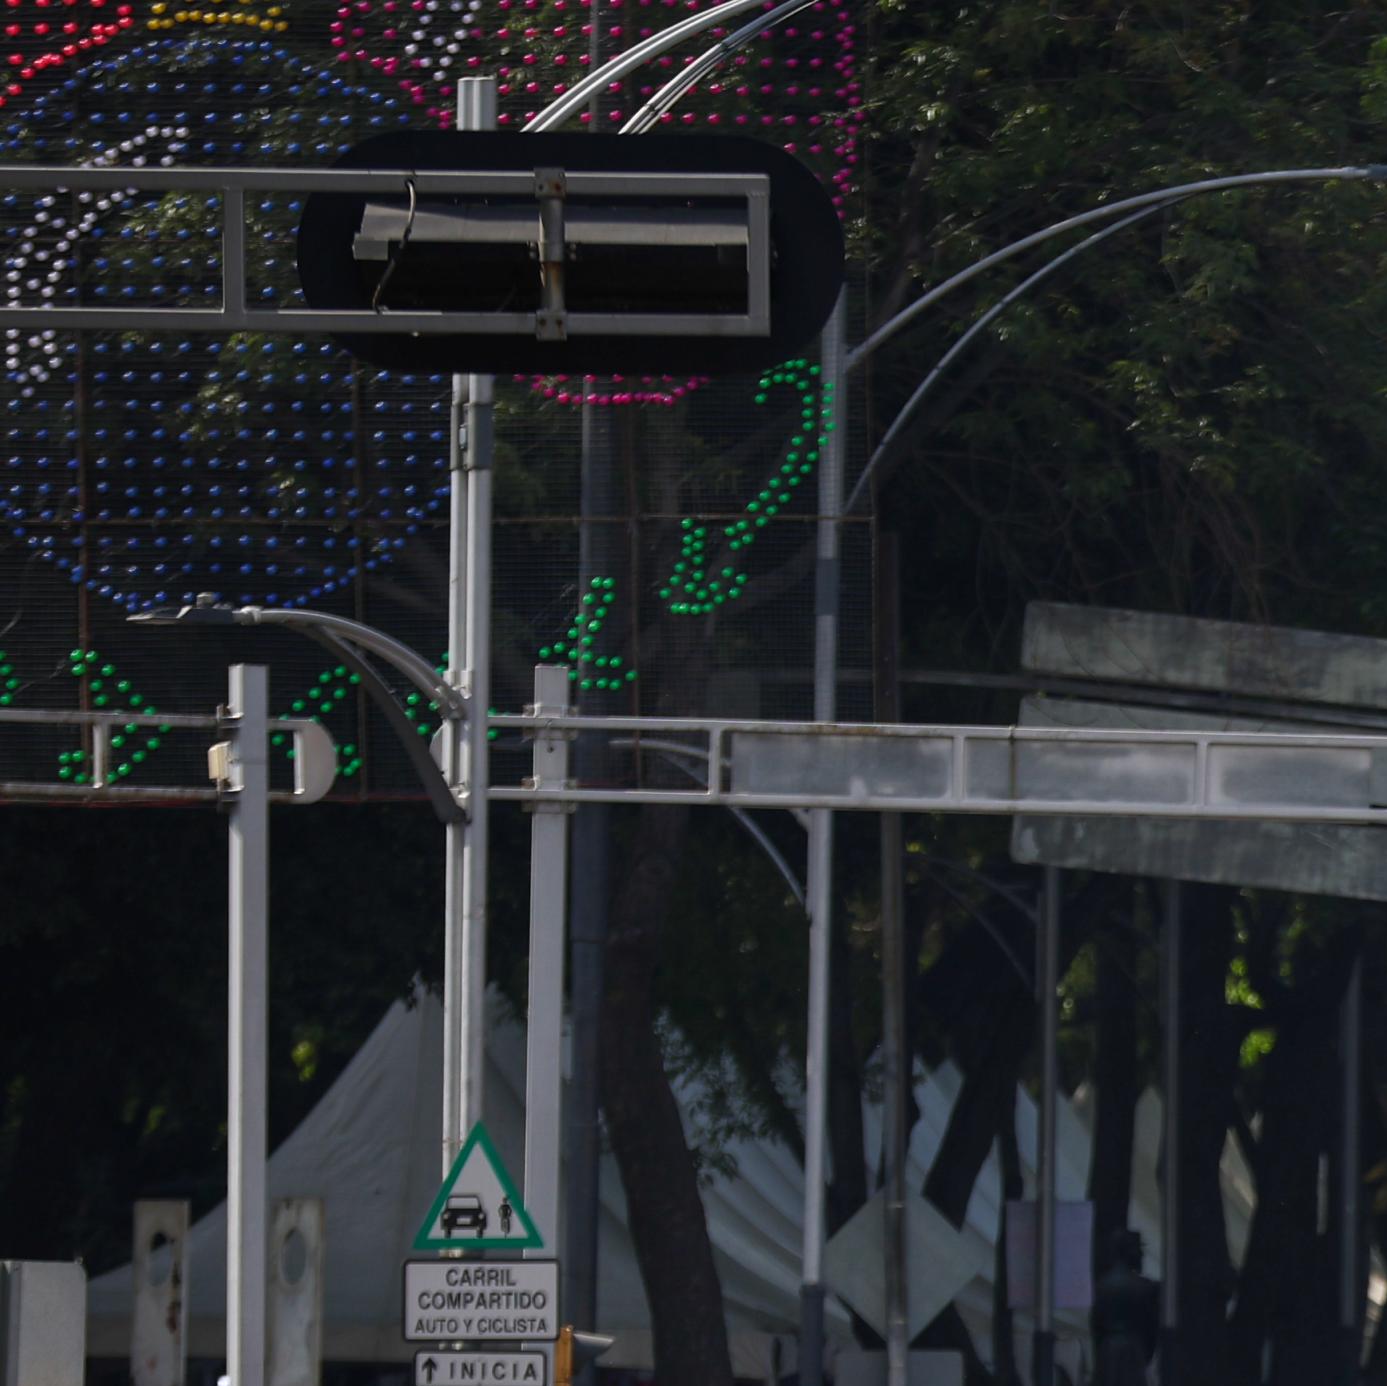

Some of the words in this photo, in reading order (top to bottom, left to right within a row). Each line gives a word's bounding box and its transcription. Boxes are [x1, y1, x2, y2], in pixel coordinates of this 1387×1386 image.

[445, 1267, 517, 1287] CARRIL
[418, 1290, 547, 1310] COMPARTIDO
[415, 1318, 458, 1333] AUTO
[463, 1318, 473, 1333] Y
[477, 1318, 547, 1334] CICLISTA
[449, 1360, 537, 1381] INICIA
